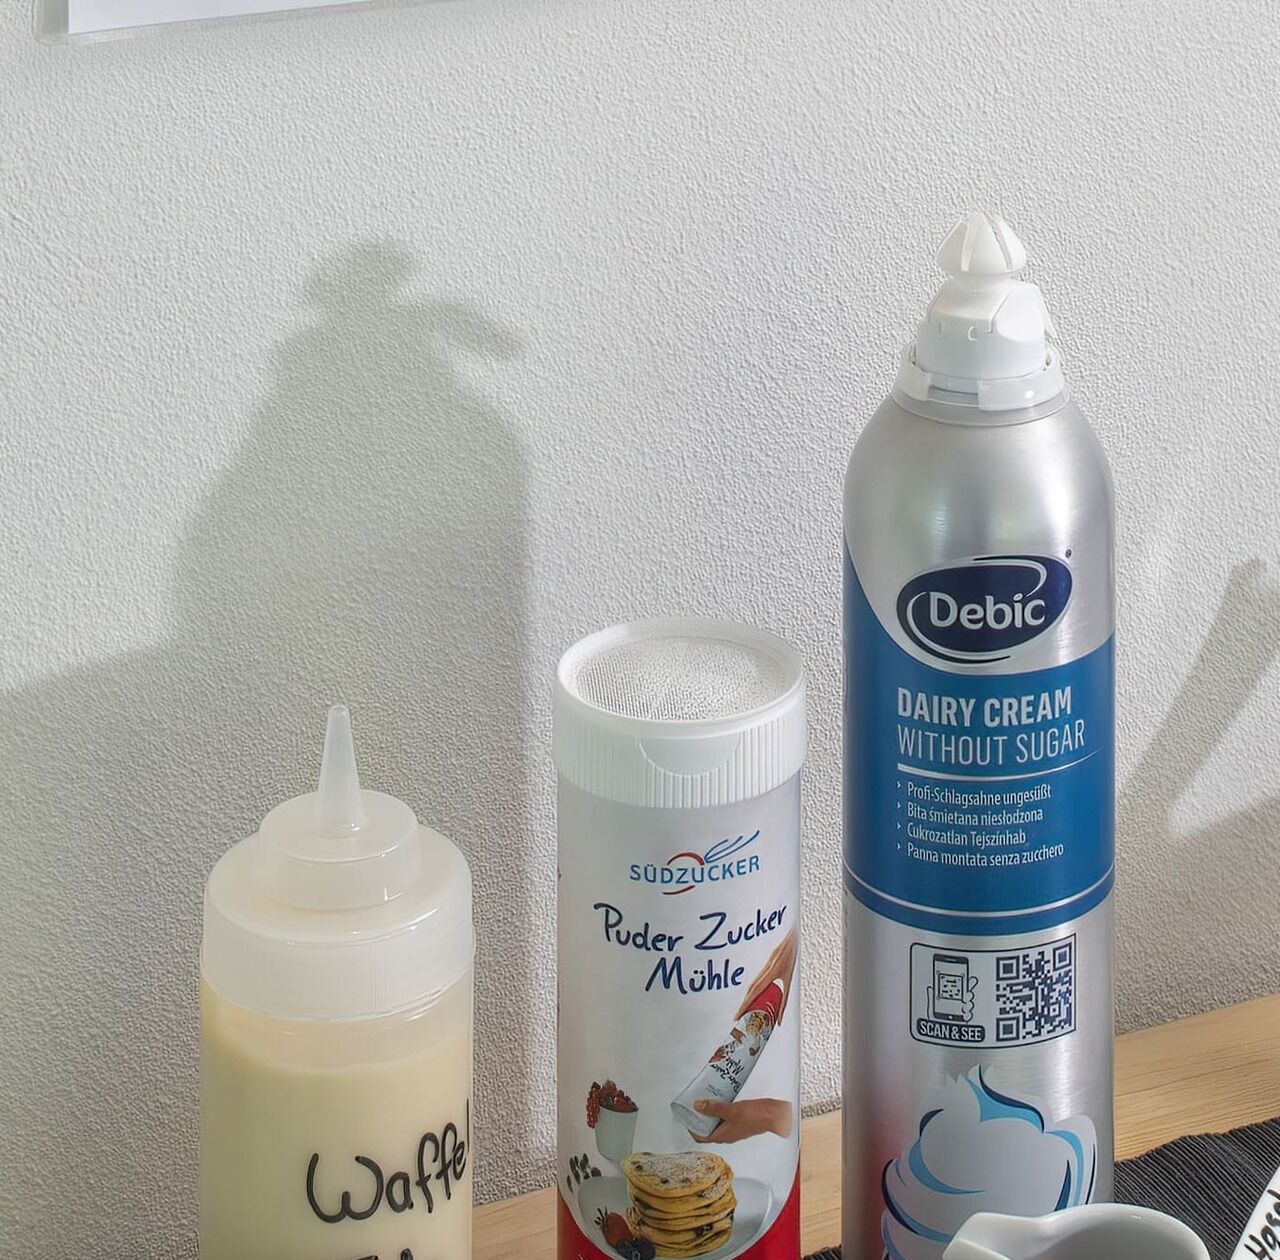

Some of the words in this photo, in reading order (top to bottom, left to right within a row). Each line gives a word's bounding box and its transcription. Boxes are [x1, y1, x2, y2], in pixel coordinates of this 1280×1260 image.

[929, 592, 1046, 630] Debic
[897, 687, 976, 728] DAIRY
[983, 686, 1072, 728] CREAM
[897, 724, 1008, 766] WITHOUT
[1015, 719, 1085, 763] SUGAR
[907, 781, 1001, 809] Profi-Schlagsahne
[1003, 783, 1052, 807] ungesüßt
[907, 802, 927, 820] Bita
[928, 806, 979, 826] śmietana
[980, 808, 1044, 827] niesłodzona
[907, 822, 968, 846] Cukrozatlan
[969, 829, 1027, 850] Tejszínhab
[629, 854, 761, 885] SÜDZUCKER
[907, 842, 939, 863] Panna
[940, 850, 988, 867] montata
[989, 853, 1020, 867] senza
[1021, 843, 1065, 865] zucchero
[593, 902, 685, 952] Puder
[694, 904, 788, 951] Zucker
[644, 955, 746, 996] Mühle
[920, 1021, 950, 1039] SCAN
[951, 1026, 960, 1040] &
[961, 1028, 982, 1041] SEE
